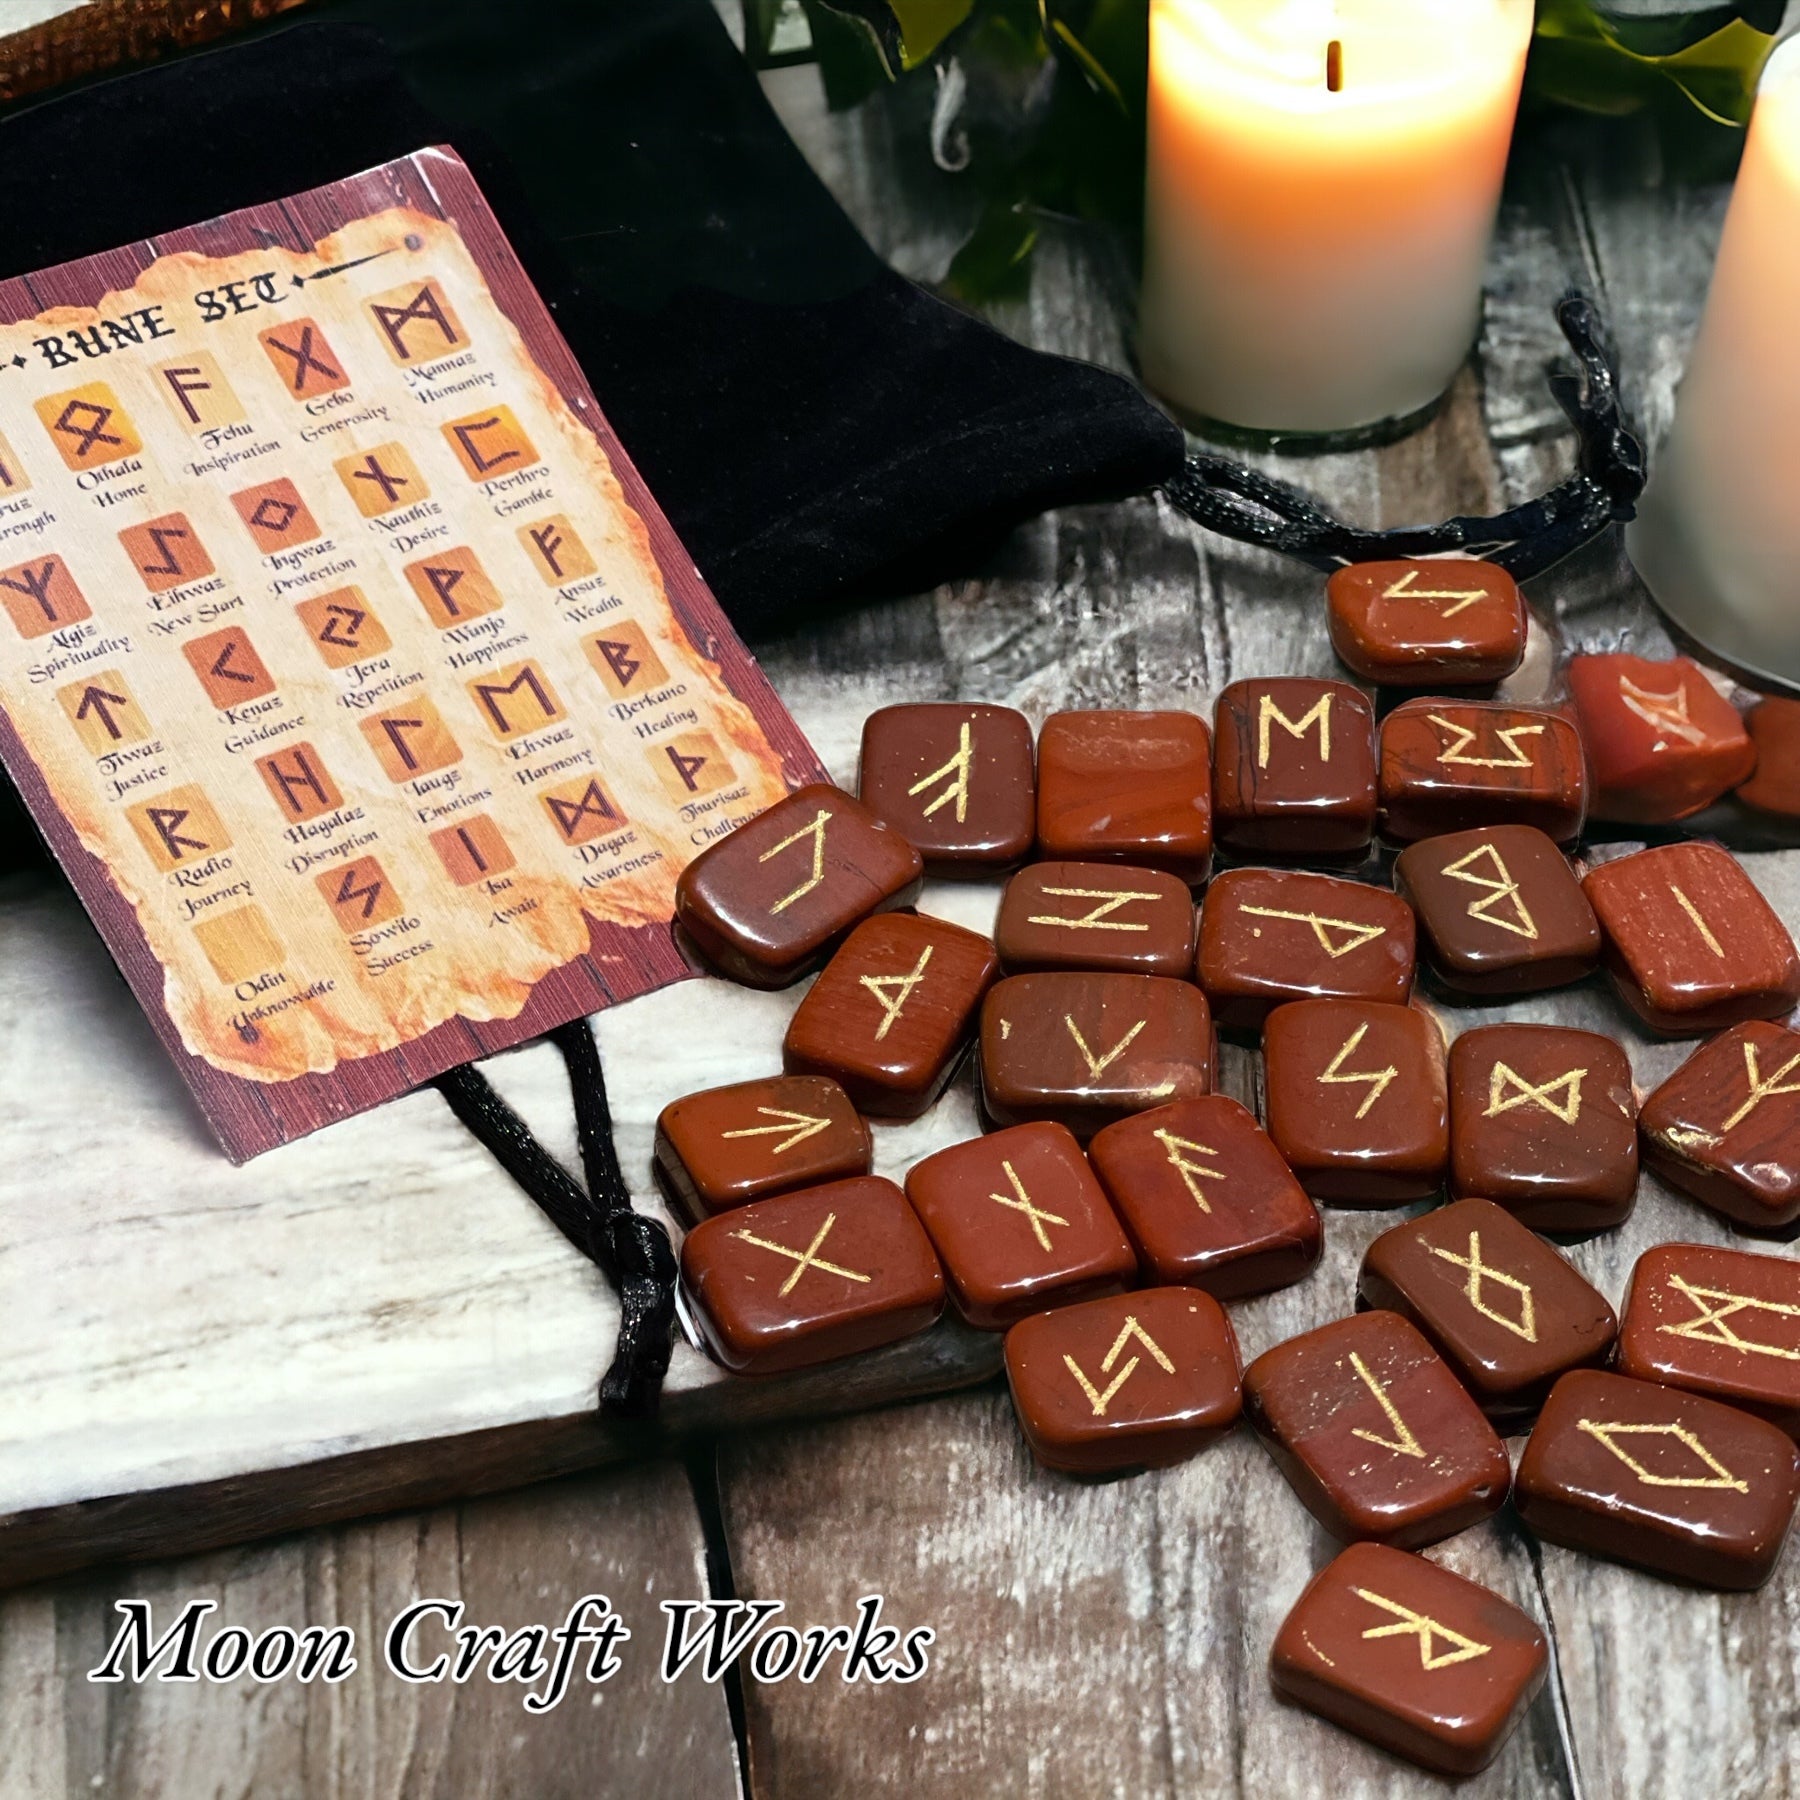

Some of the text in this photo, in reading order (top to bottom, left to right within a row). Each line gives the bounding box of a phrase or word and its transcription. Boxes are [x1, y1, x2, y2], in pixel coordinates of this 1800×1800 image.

[33, 272, 288, 368] RUNE SET
[305, 391, 353, 416] Gebo
[415, 372, 496, 403] Humanity
[200, 423, 253, 449] Fehu
[301, 406, 390, 442] Generosity
[76, 459, 142, 490] Othala
[478, 466, 550, 497] Perthro
[92, 483, 147, 507] Home
[390, 524, 449, 553] Desire
[267, 559, 357, 600] Protection
[149, 595, 245, 637] New Start
[562, 595, 624, 624] Wealth
[442, 615, 506, 645] Wunjo
[27, 636, 132, 684] Spirituality
[444, 632, 529, 670] Happiness
[346, 658, 391, 689] Jera
[608, 683, 687, 722] Berkano
[224, 714, 305, 754] Guidance
[632, 707, 698, 739] Healing
[106, 765, 168, 801] Justice
[512, 749, 595, 785] Harmony
[415, 788, 493, 824] Emotions
[285, 830, 379, 875] Disruption
[579, 849, 663, 892] Awareness
[178, 881, 254, 921] Journey
[478, 877, 513, 896] Isa
[488, 897, 538, 928] Await
[350, 917, 421, 955] Sowilo
[367, 940, 434, 977] Success
[235, 972, 286, 1001] Odin
